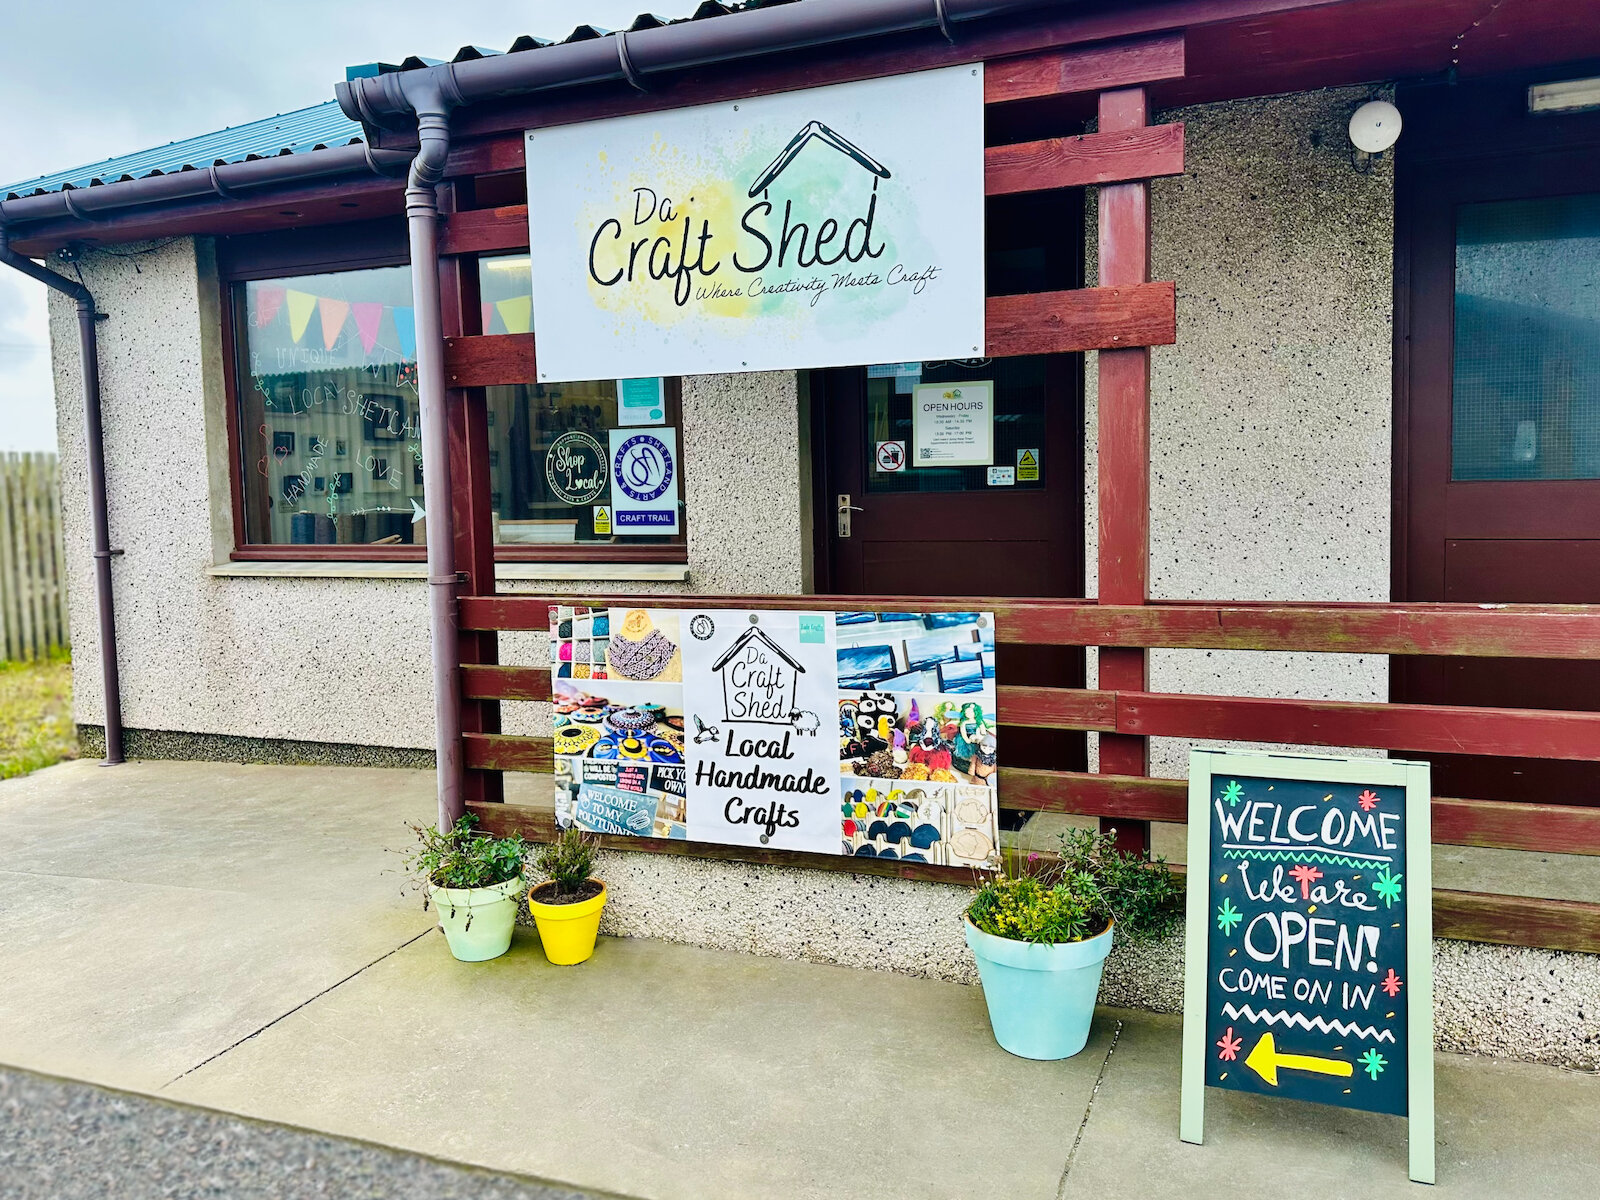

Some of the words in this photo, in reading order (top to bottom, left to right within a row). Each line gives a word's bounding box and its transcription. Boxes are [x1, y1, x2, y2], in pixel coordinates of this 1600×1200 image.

[633, 187, 678, 225] Da
[588, 217, 720, 306] Craft
[733, 194, 885, 273] Shed
[696, 281, 743, 300] Where
[747, 277, 829, 307] Creativity
[831, 272, 882, 288] Meets
[886, 264, 942, 295] Craft
[288, 379, 346, 416] LOCAL
[923, 403, 949, 412] OPEN
[950, 401, 984, 411] HOURS
[282, 434, 329, 507] HANDMADE
[355, 448, 404, 490] LOVE
[556, 446, 585, 474] Shop
[614, 437, 637, 477] CRAFTS
[647, 436, 673, 491] SHETLAND
[619, 481, 628, 490] &
[629, 489, 656, 501] ARTS
[619, 514, 646, 523] CRAFT
[647, 514, 671, 522] TRAIL
[746, 646, 768, 665] Da
[731, 661, 785, 699] Craft
[731, 691, 787, 719] Shed
[725, 729, 795, 760] Local
[657, 766, 675, 780] PICK
[664, 780, 686, 795] OWN
[695, 760, 830, 795] Handmade
[587, 788, 638, 813] WELCOME
[592, 802, 605, 815] TO
[604, 808, 624, 823] MY
[724, 797, 800, 837] Crafts
[577, 808, 640, 837] POLYTUNN
[1214, 797, 1401, 851] WELCOME
[1237, 860, 1298, 904] We
[1310, 880, 1377, 912] are
[1244, 911, 1381, 974] OPEN!
[1218, 967, 1288, 1000] COME
[1293, 978, 1333, 1005] ON
[1342, 983, 1376, 1010] IN
